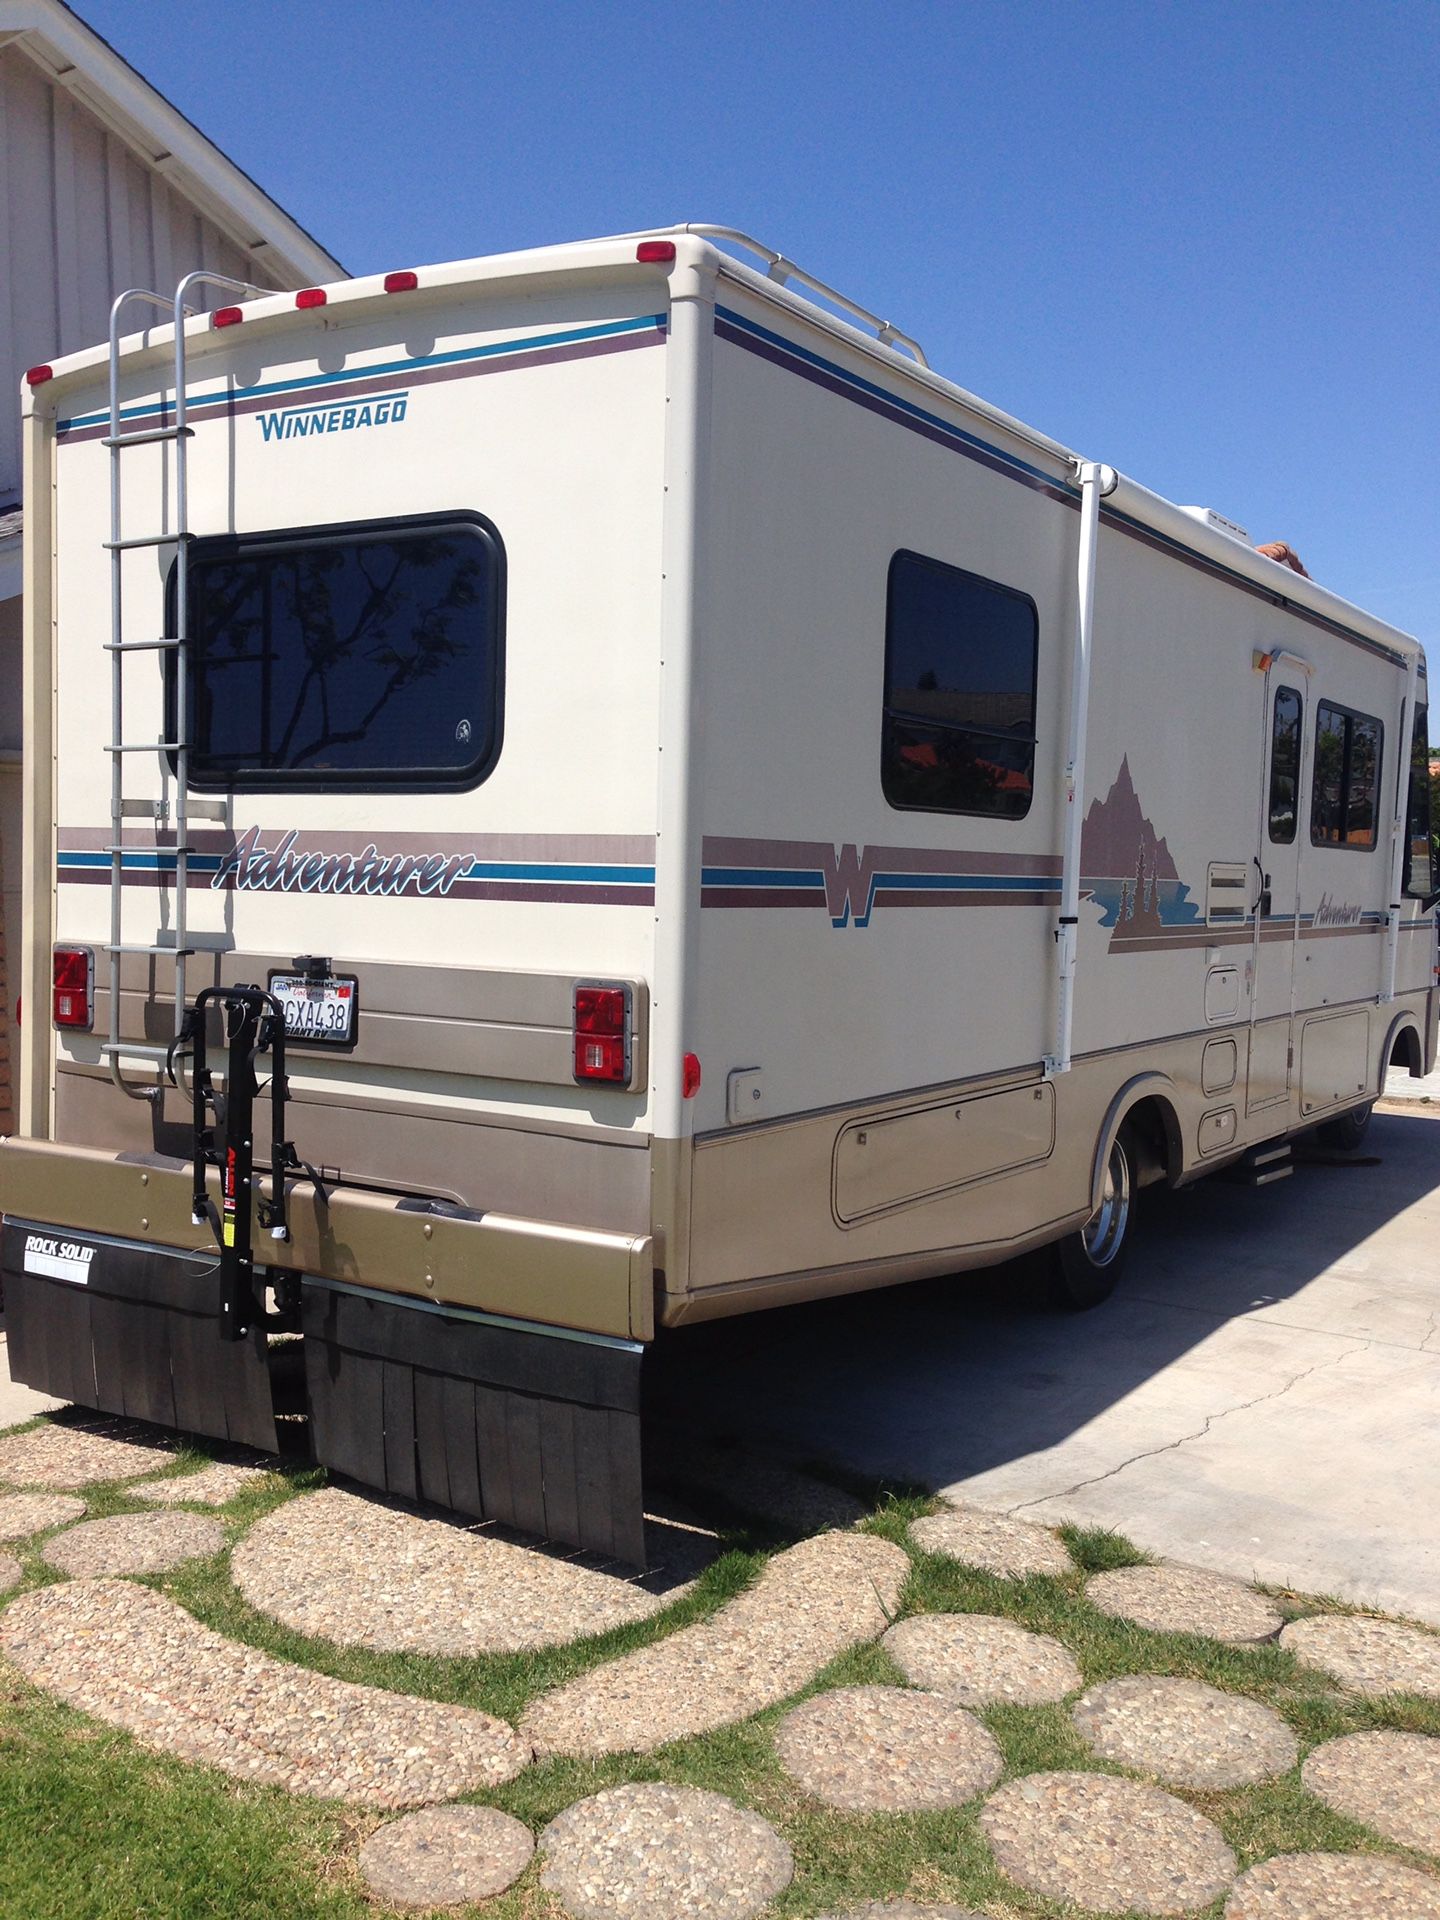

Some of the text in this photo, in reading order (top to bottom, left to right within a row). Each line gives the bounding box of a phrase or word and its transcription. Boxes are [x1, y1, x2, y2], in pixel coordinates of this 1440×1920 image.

[256, 391, 409, 442] WINNEBAGO
[211, 824, 476, 895] Adventurer
[823, 844, 873, 928] W
[1313, 892, 1362, 926] Adventurer
[285, 1026, 328, 1038] GIANT RV
[227, 1146, 236, 1197] ALLEN
[25, 1235, 94, 1262] ROCK SOLID
